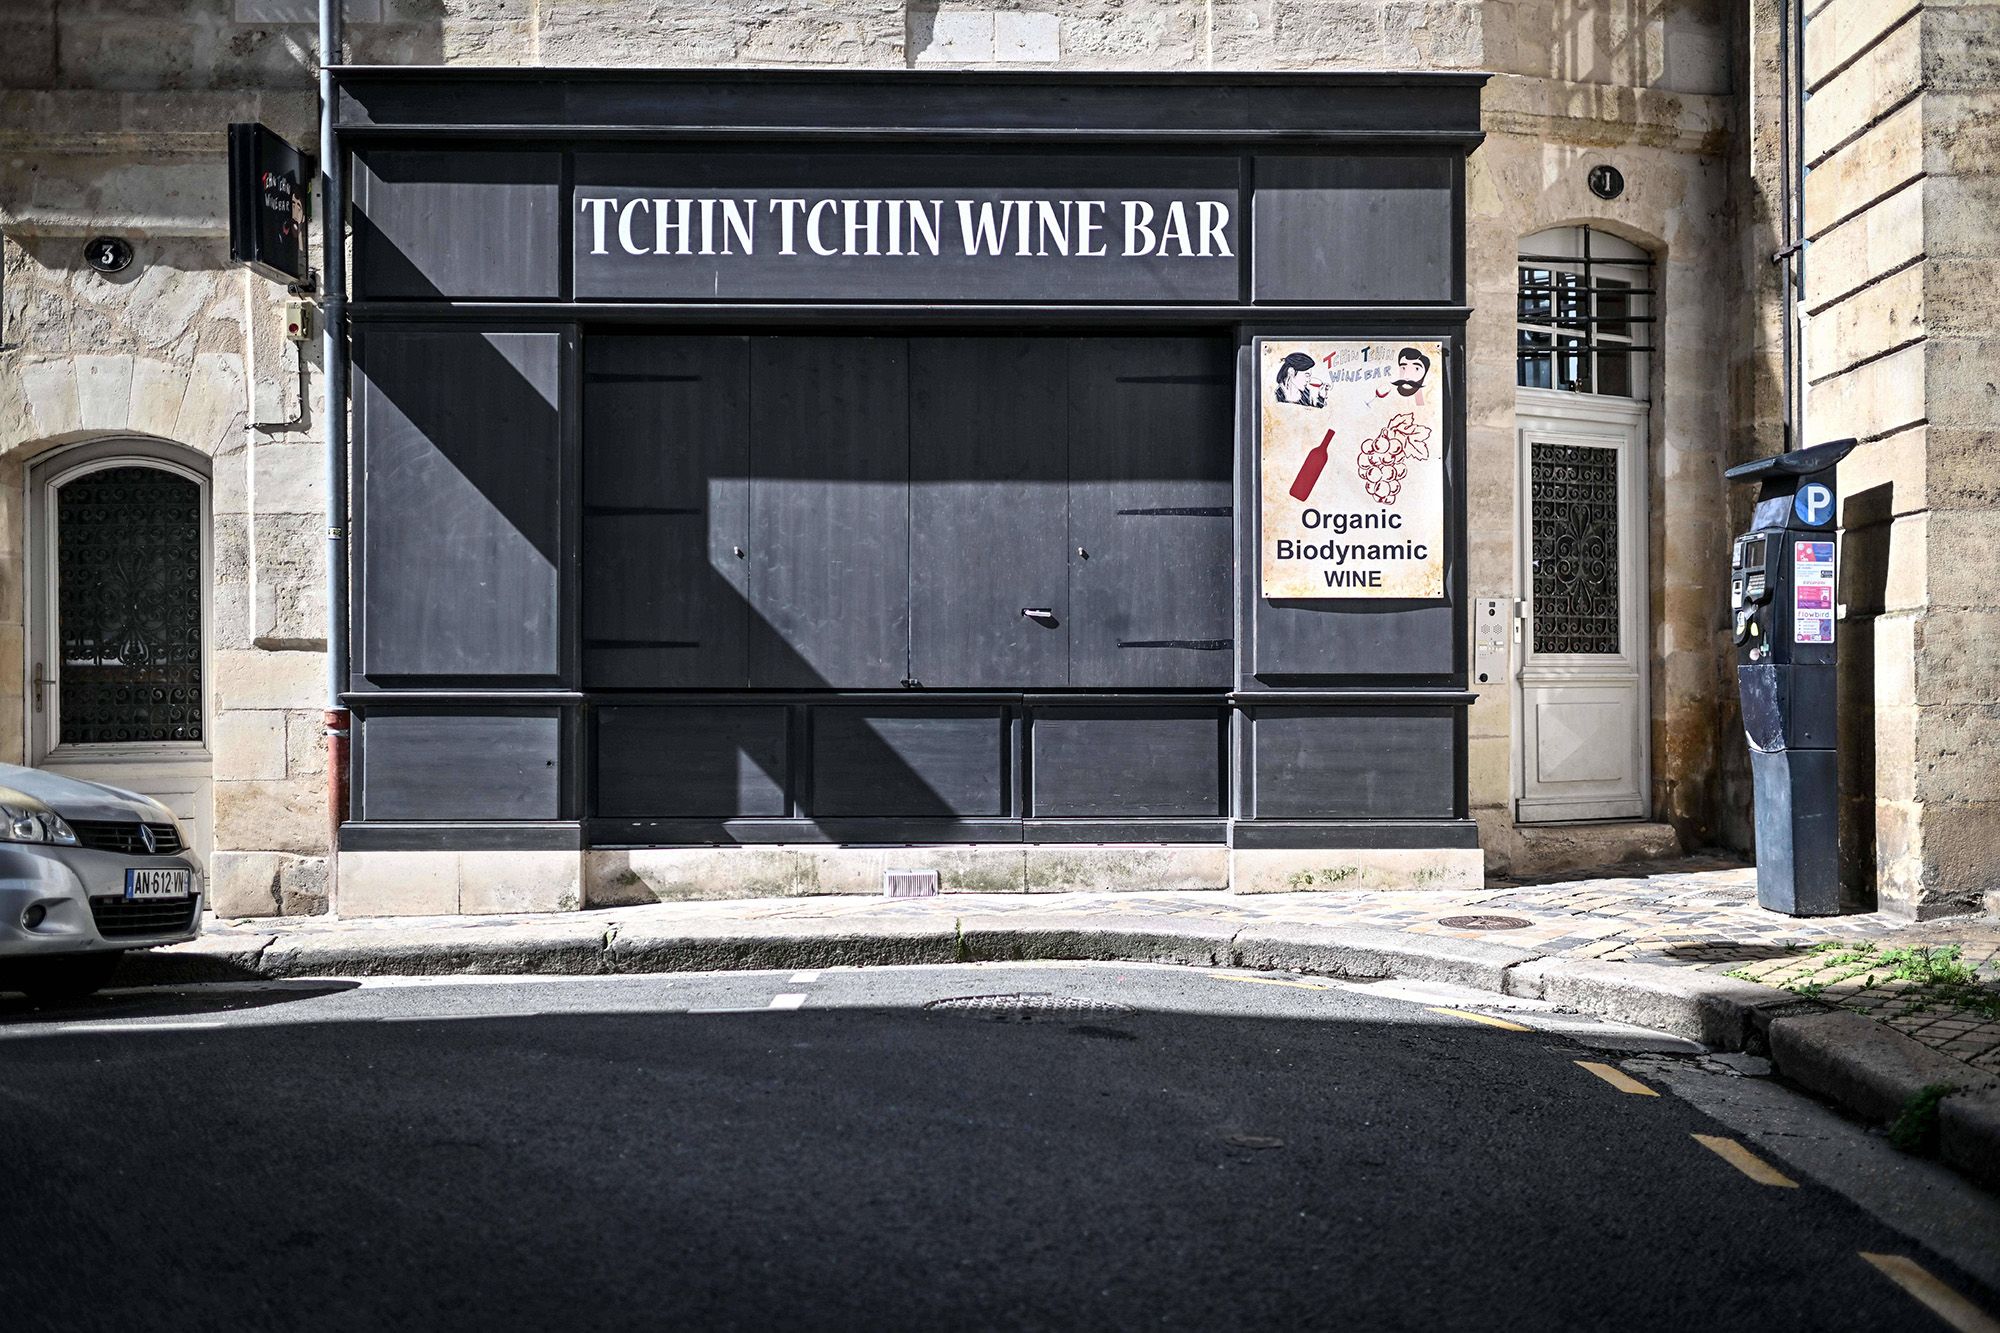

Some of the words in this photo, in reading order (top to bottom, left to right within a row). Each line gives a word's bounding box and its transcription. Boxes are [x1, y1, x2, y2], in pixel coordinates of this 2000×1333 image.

[581, 198, 757, 257] TCHIN
[769, 198, 944, 257] TCHIN
[954, 200, 1107, 258] WINE
[1120, 200, 1235, 258] BAR
[101, 244, 114, 264] 3
[1807, 486, 1831, 523] P
[1301, 508, 1402, 534] Organic
[1277, 539, 1428, 565] Biodynamic
[1324, 570, 1382, 588] WINE
